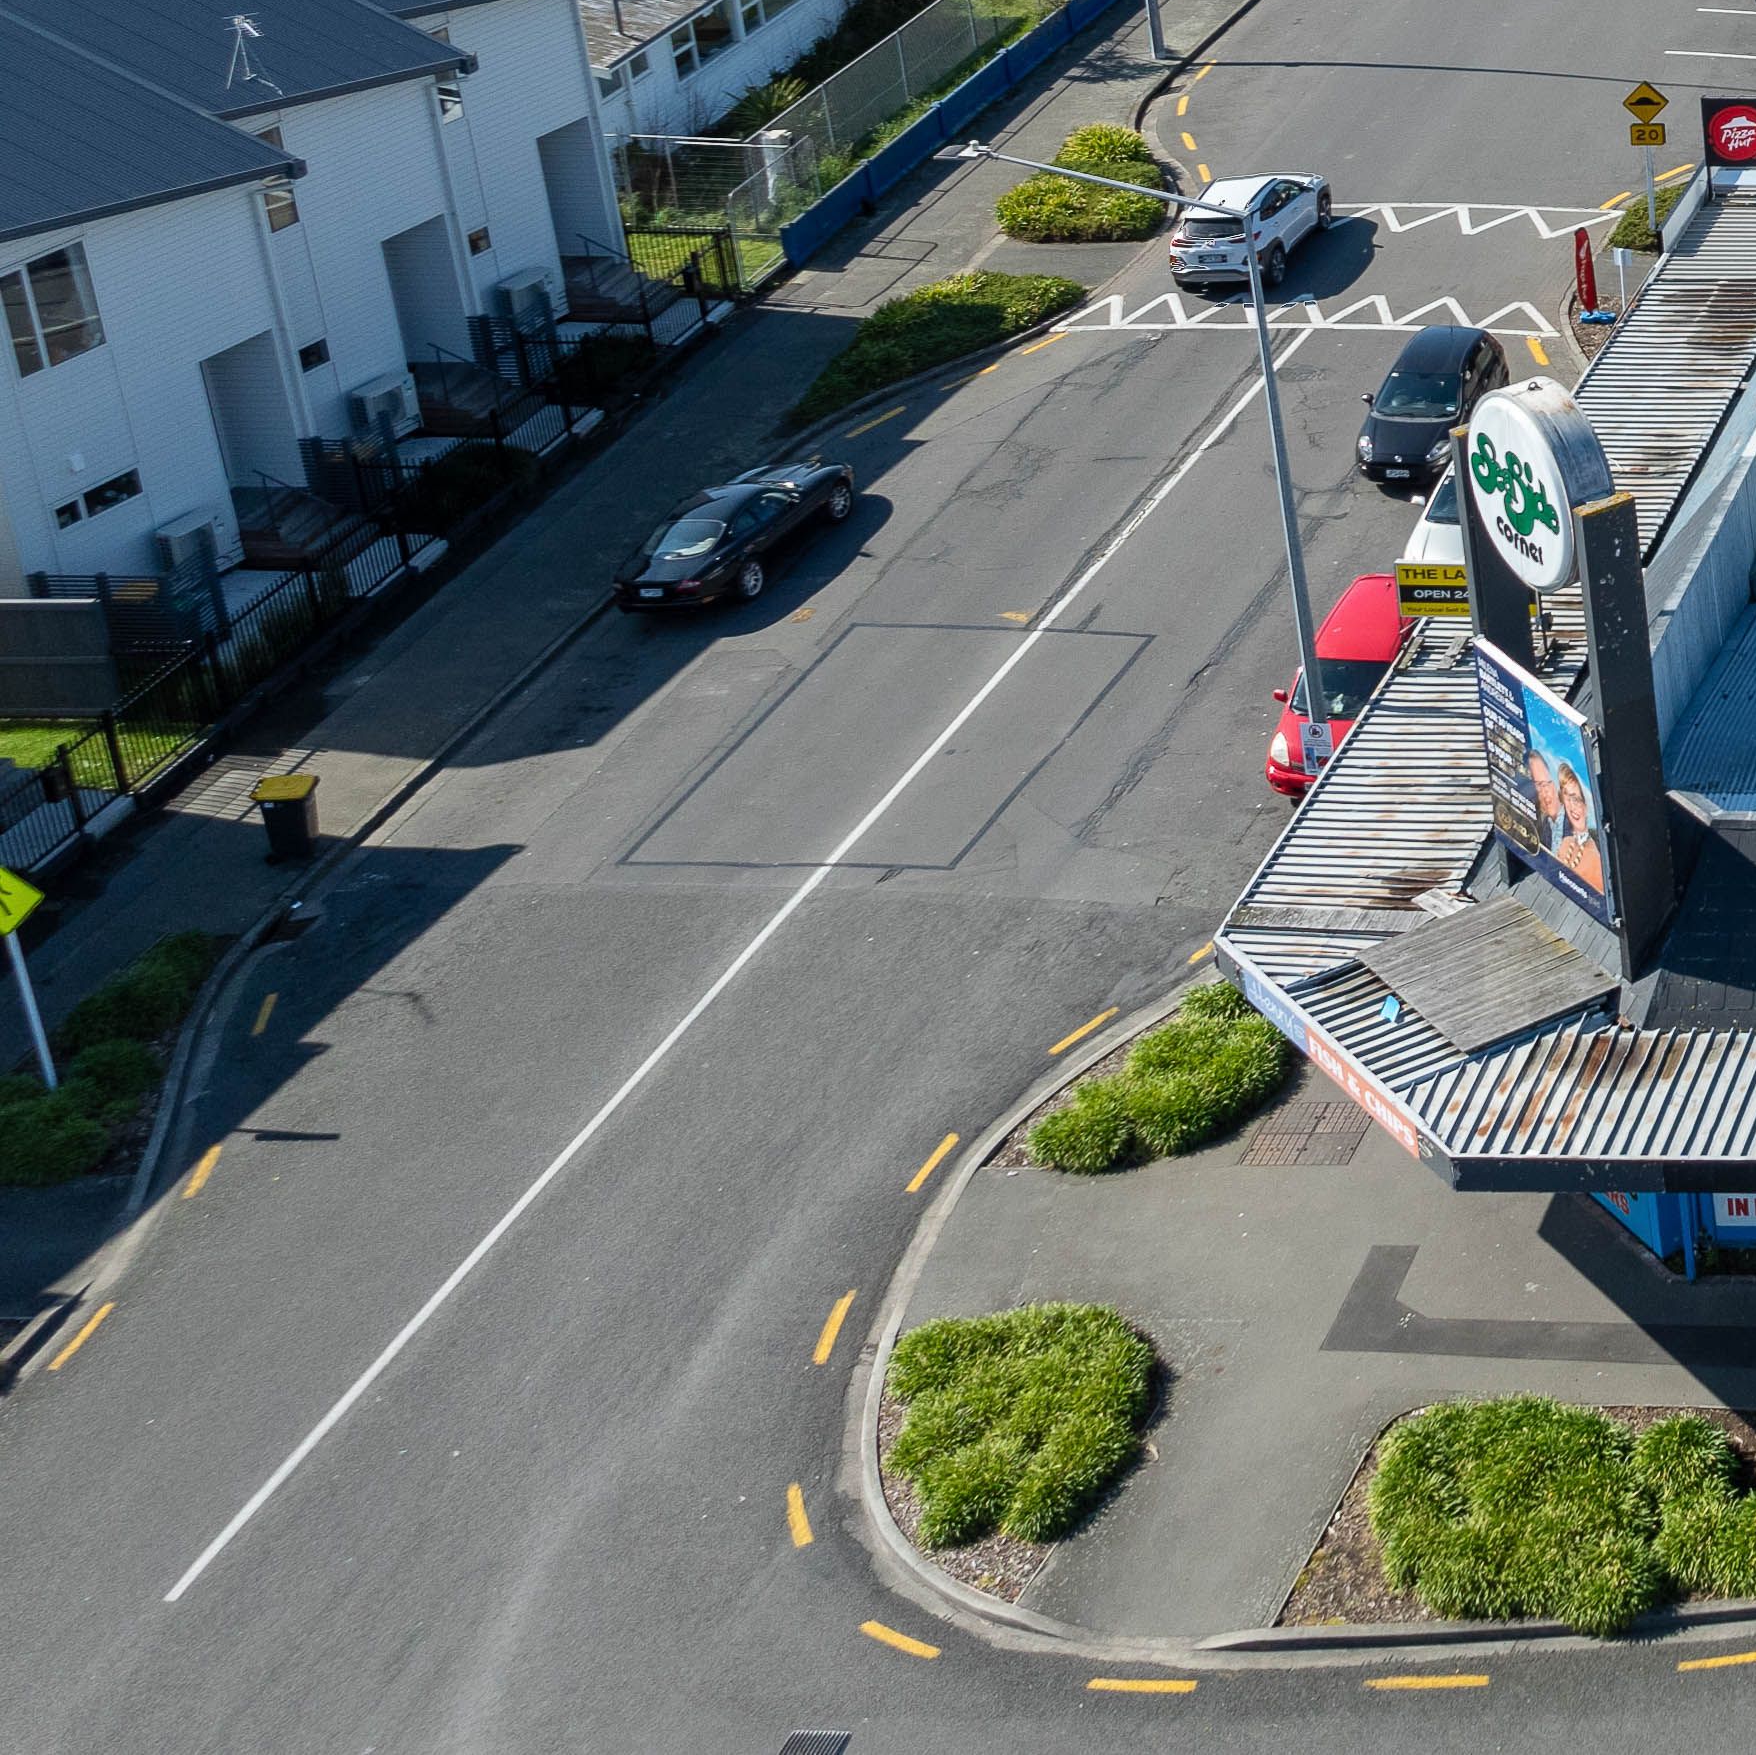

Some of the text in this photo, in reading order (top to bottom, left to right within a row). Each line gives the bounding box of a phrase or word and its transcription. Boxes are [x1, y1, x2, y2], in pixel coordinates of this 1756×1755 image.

[1635, 128, 1659, 141] 20
[1721, 127, 1756, 143] Pizza
[1728, 137, 1755, 151] Hut
[1401, 568, 1438, 579] THE
[1414, 589, 1450, 598] OPEN
[1308, 1035, 1345, 1081] FISH
[1364, 1090, 1415, 1147] CHIPS
[1727, 1197, 1749, 1217] IN
